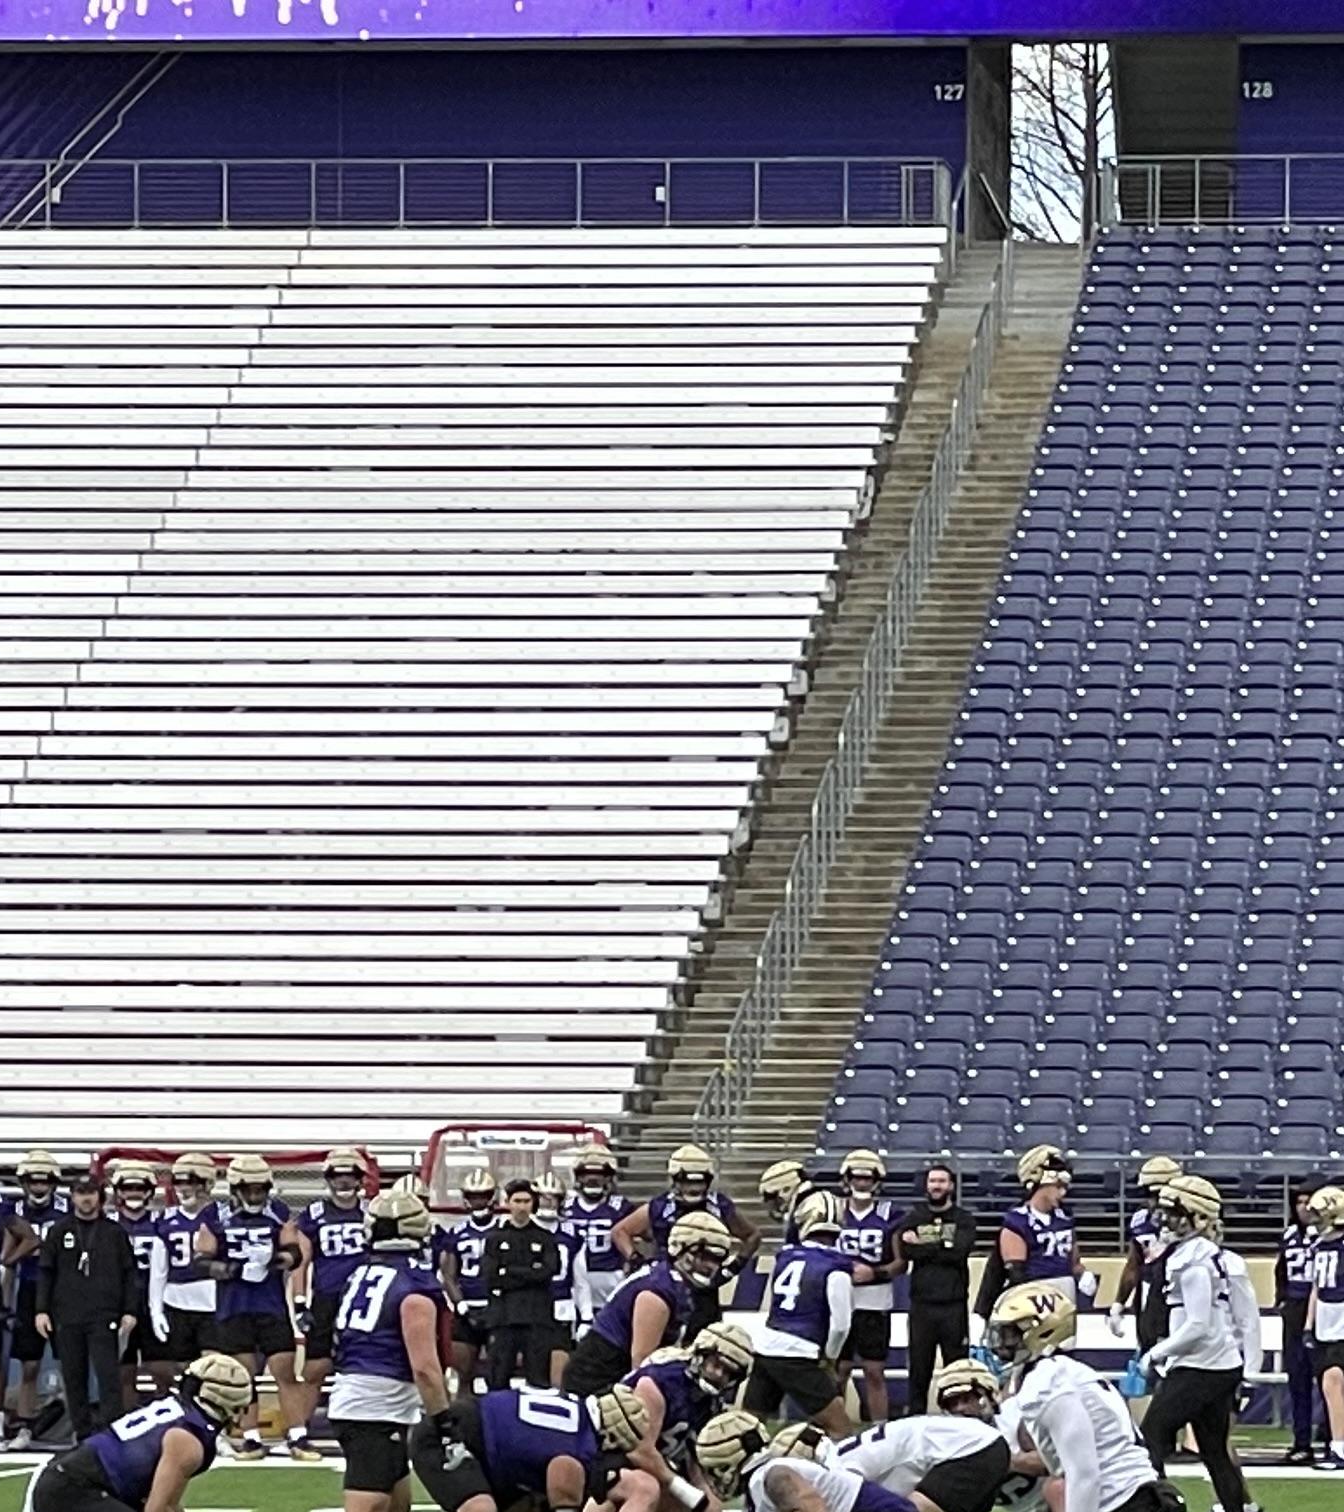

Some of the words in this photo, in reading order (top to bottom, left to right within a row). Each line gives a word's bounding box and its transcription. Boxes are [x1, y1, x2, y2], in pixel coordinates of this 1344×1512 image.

[934, 84, 964, 101] 127
[1242, 82, 1273, 98] 128
[319, 1224, 367, 1258] 65
[336, 1264, 398, 1333] 13
[773, 1260, 807, 1312] 4
